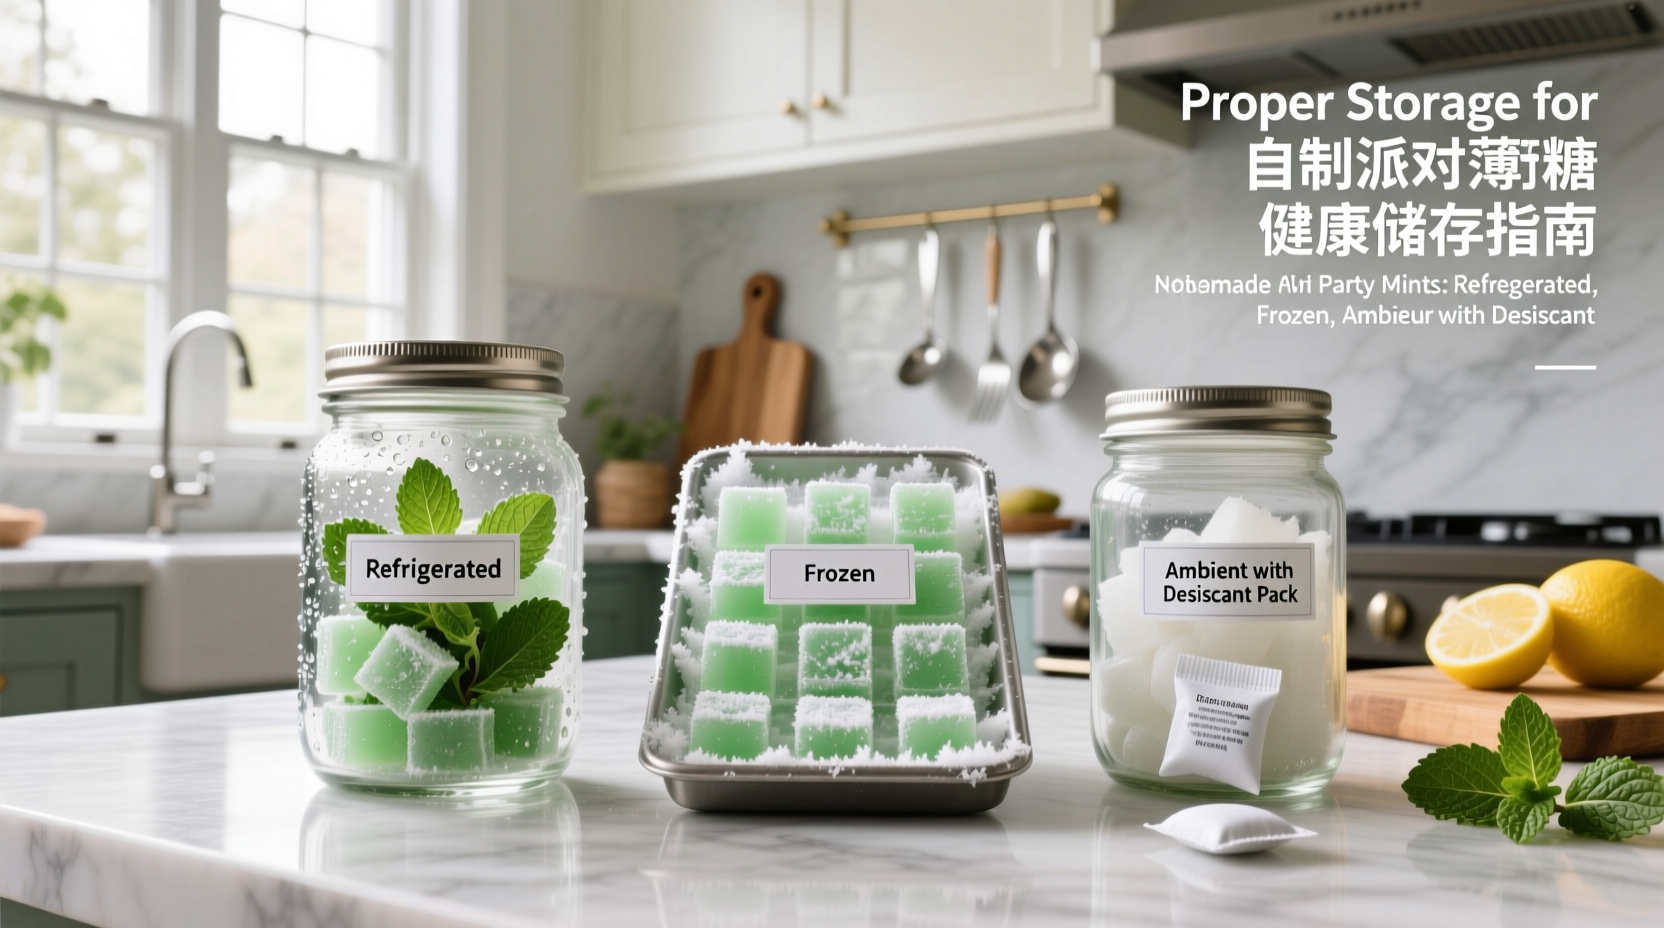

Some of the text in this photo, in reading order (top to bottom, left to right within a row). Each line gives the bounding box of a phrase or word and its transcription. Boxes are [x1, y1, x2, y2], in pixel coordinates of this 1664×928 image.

[366, 557, 502, 585] Refrigerated
[804, 563, 875, 583] Frozen
[1165, 560, 1294, 580] Ambient with
[1163, 583, 1299, 604] Desiscant Pack
